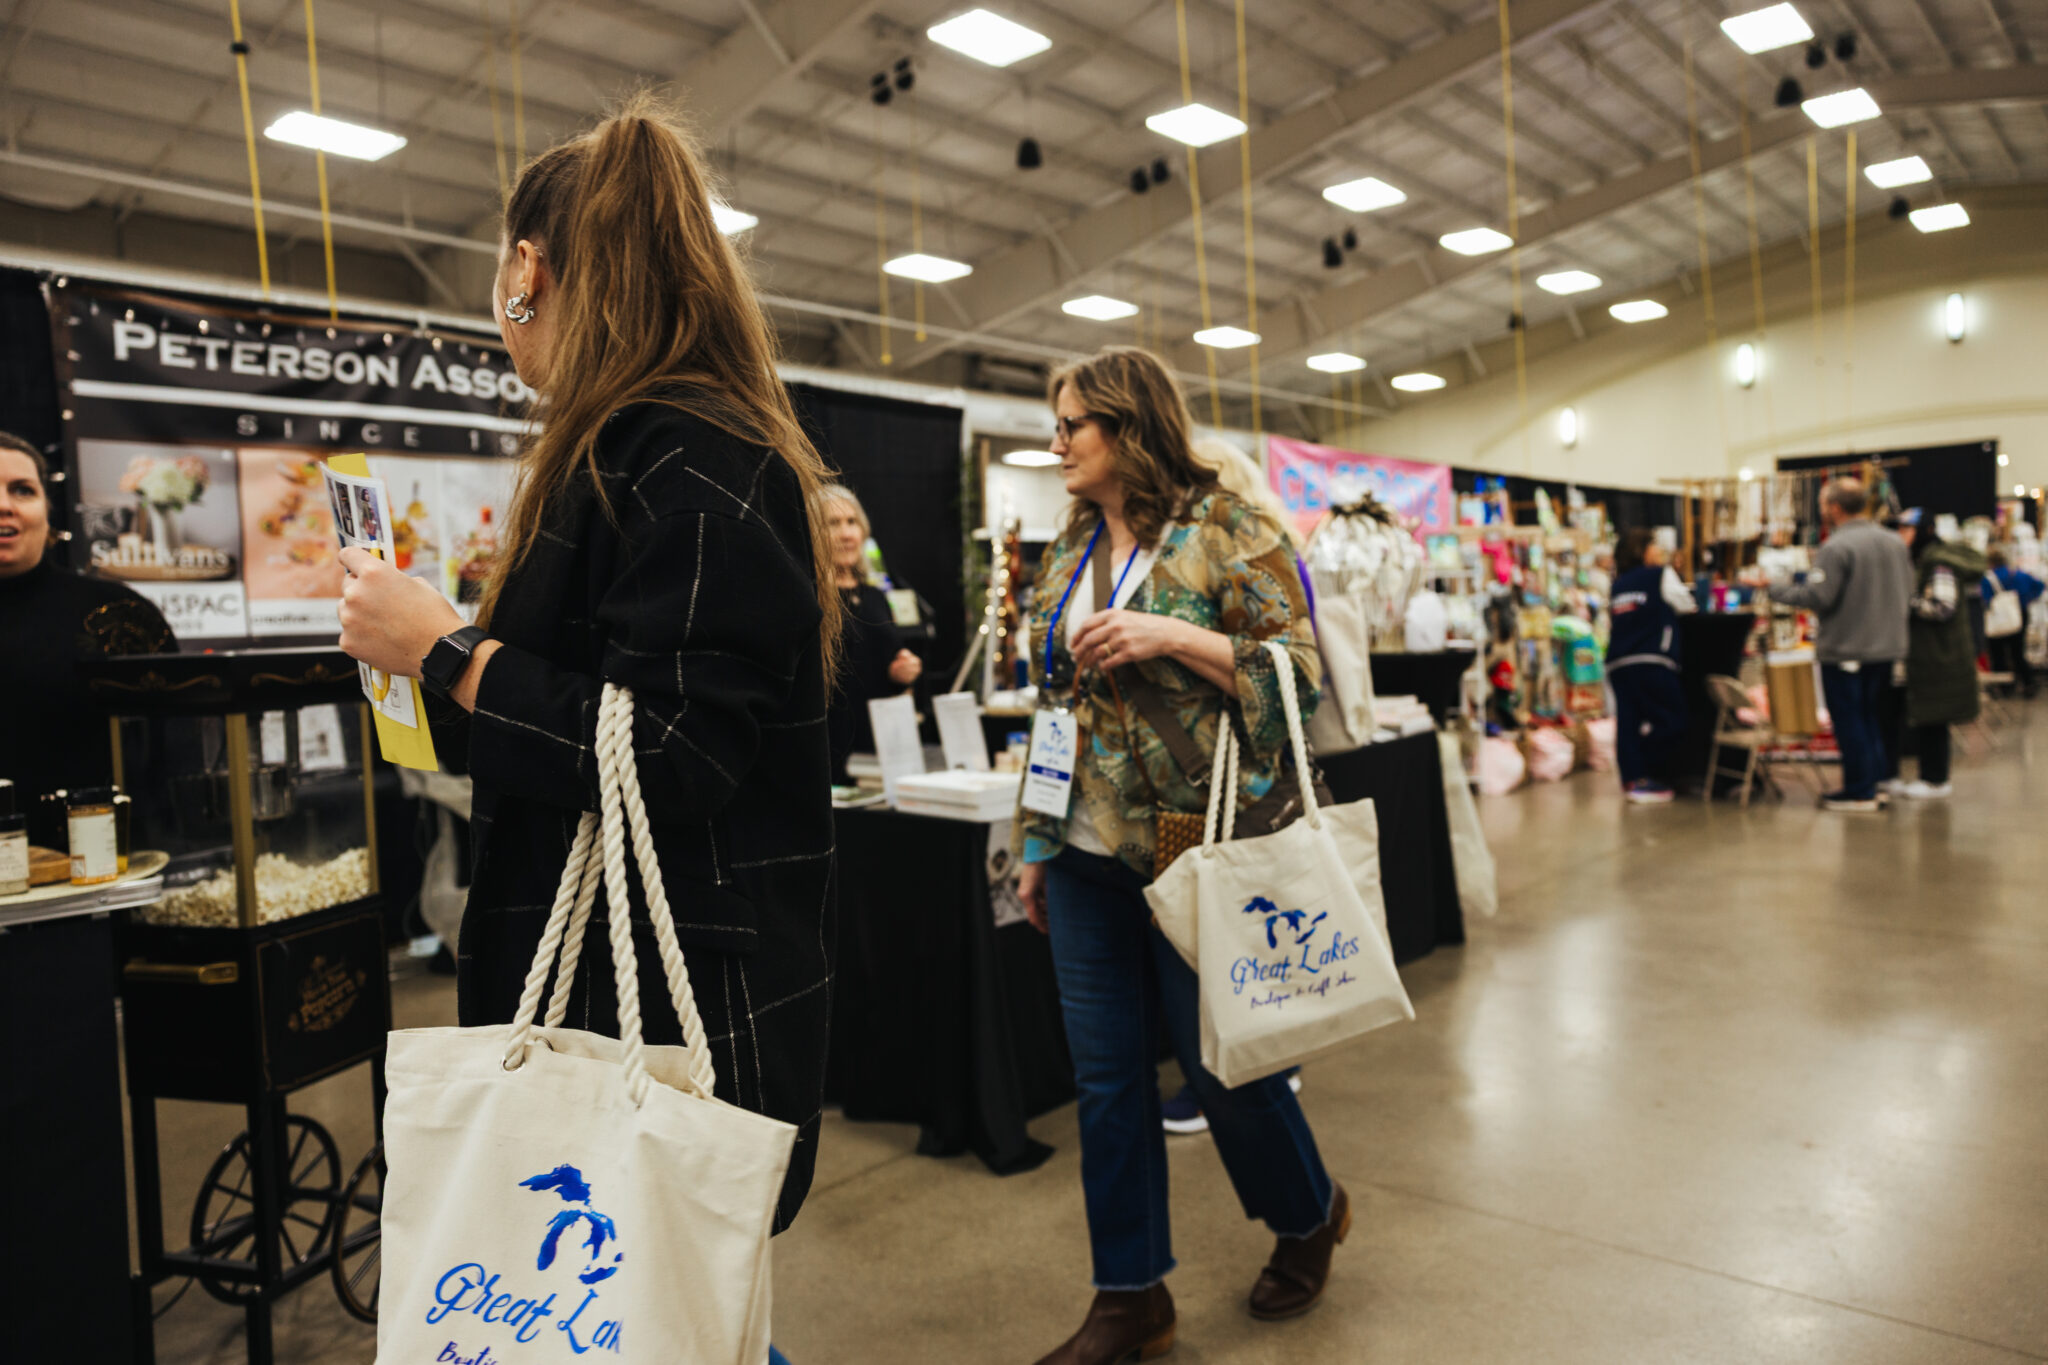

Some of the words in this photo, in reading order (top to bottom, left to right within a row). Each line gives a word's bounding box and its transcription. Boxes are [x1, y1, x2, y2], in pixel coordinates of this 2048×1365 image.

[112, 318, 399, 389] PETERSON
[236, 413, 420, 448] SINCE
[1230, 955, 1291, 996] Great
[1298, 930, 1359, 974] Lakes
[425, 1262, 558, 1344] Great
